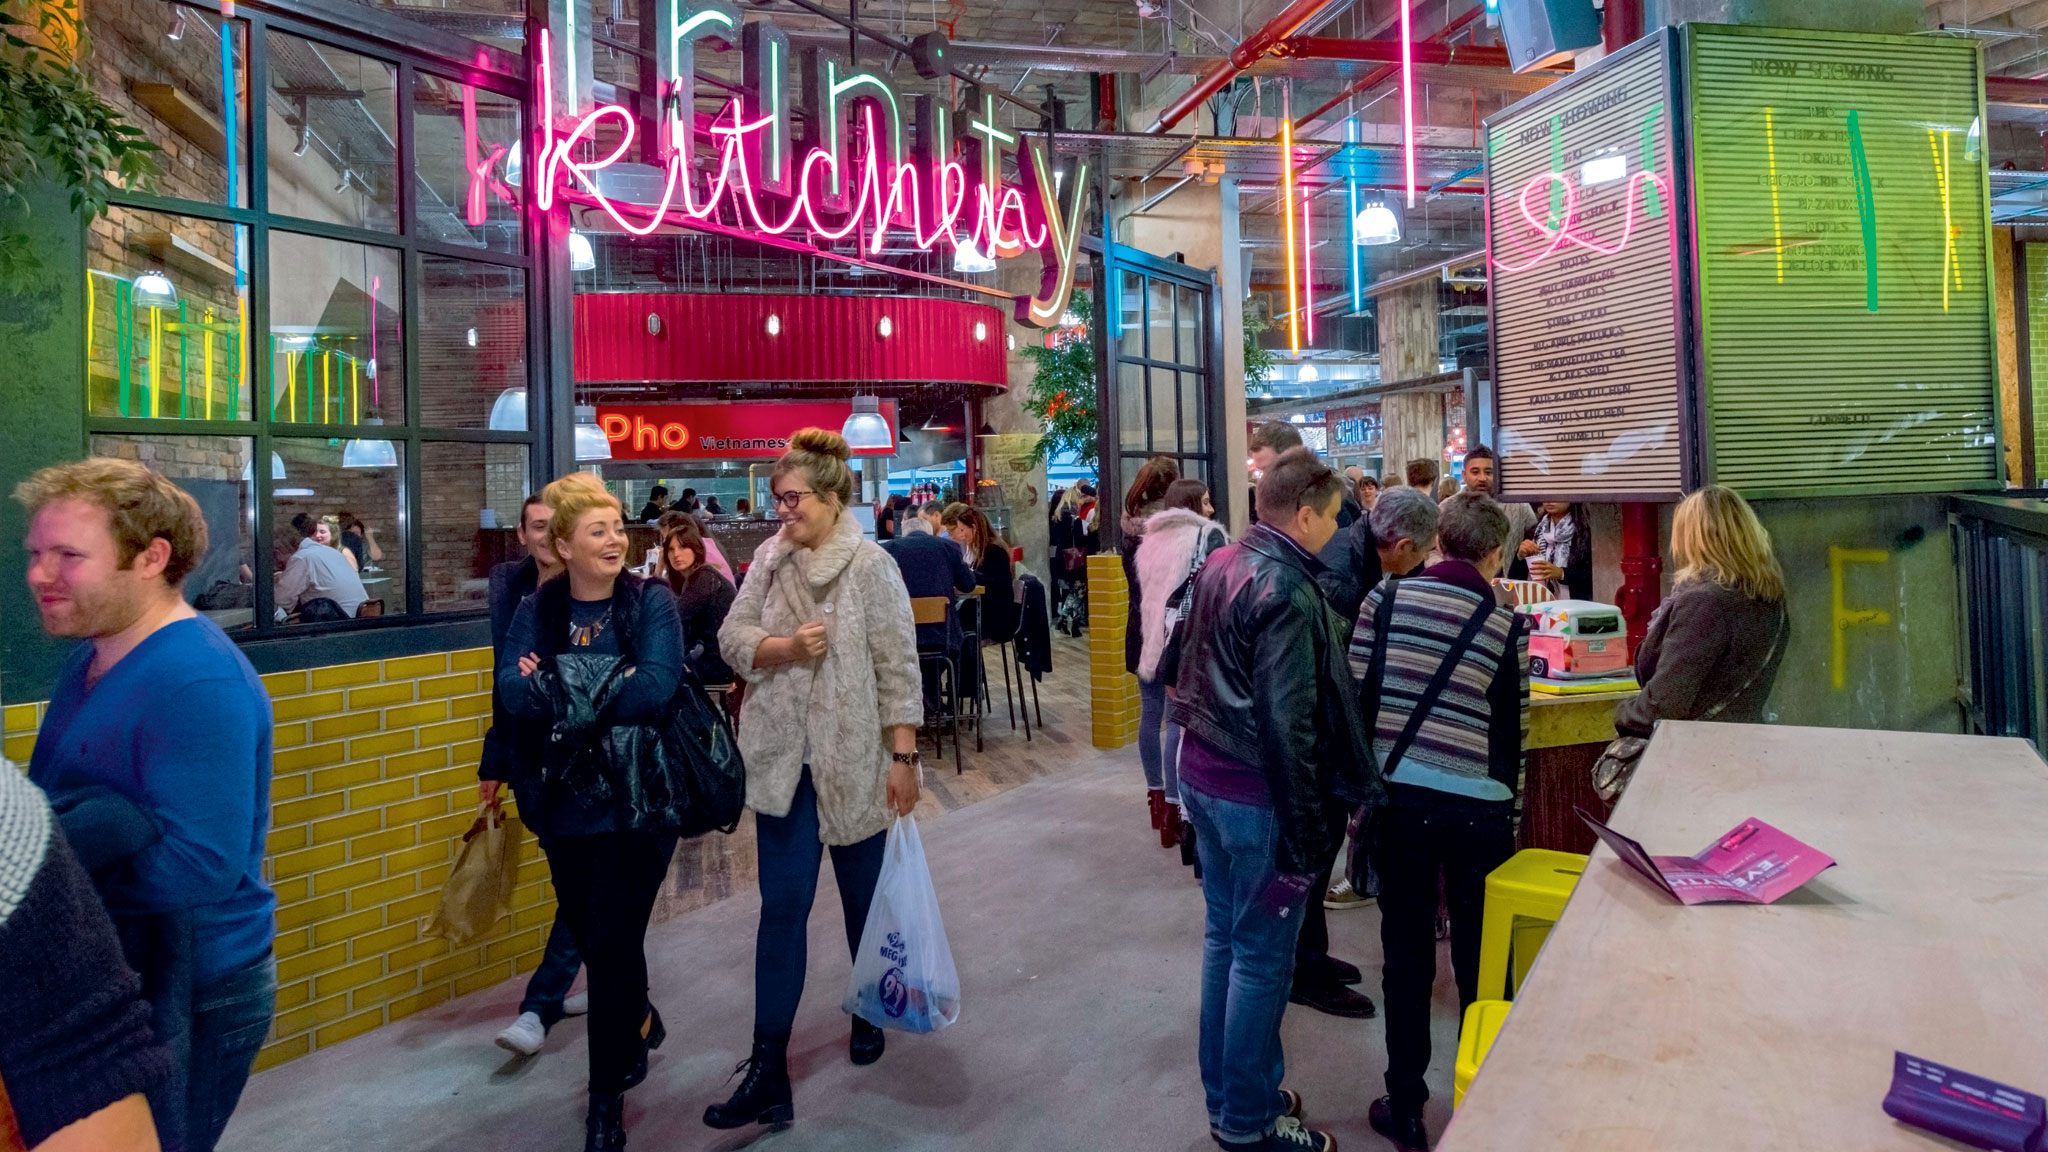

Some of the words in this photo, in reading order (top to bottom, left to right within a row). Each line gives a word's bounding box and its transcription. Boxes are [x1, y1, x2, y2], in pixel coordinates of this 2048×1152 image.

[1751, 58, 1798, 77] NOW
[1809, 61, 1894, 81] SHOWING
[1519, 120, 1551, 145] NOW
[1587, 384, 1630, 398] KITCHEN
[1584, 405, 1624, 420] KITCHEN
[600, 412, 690, 451] Pho
